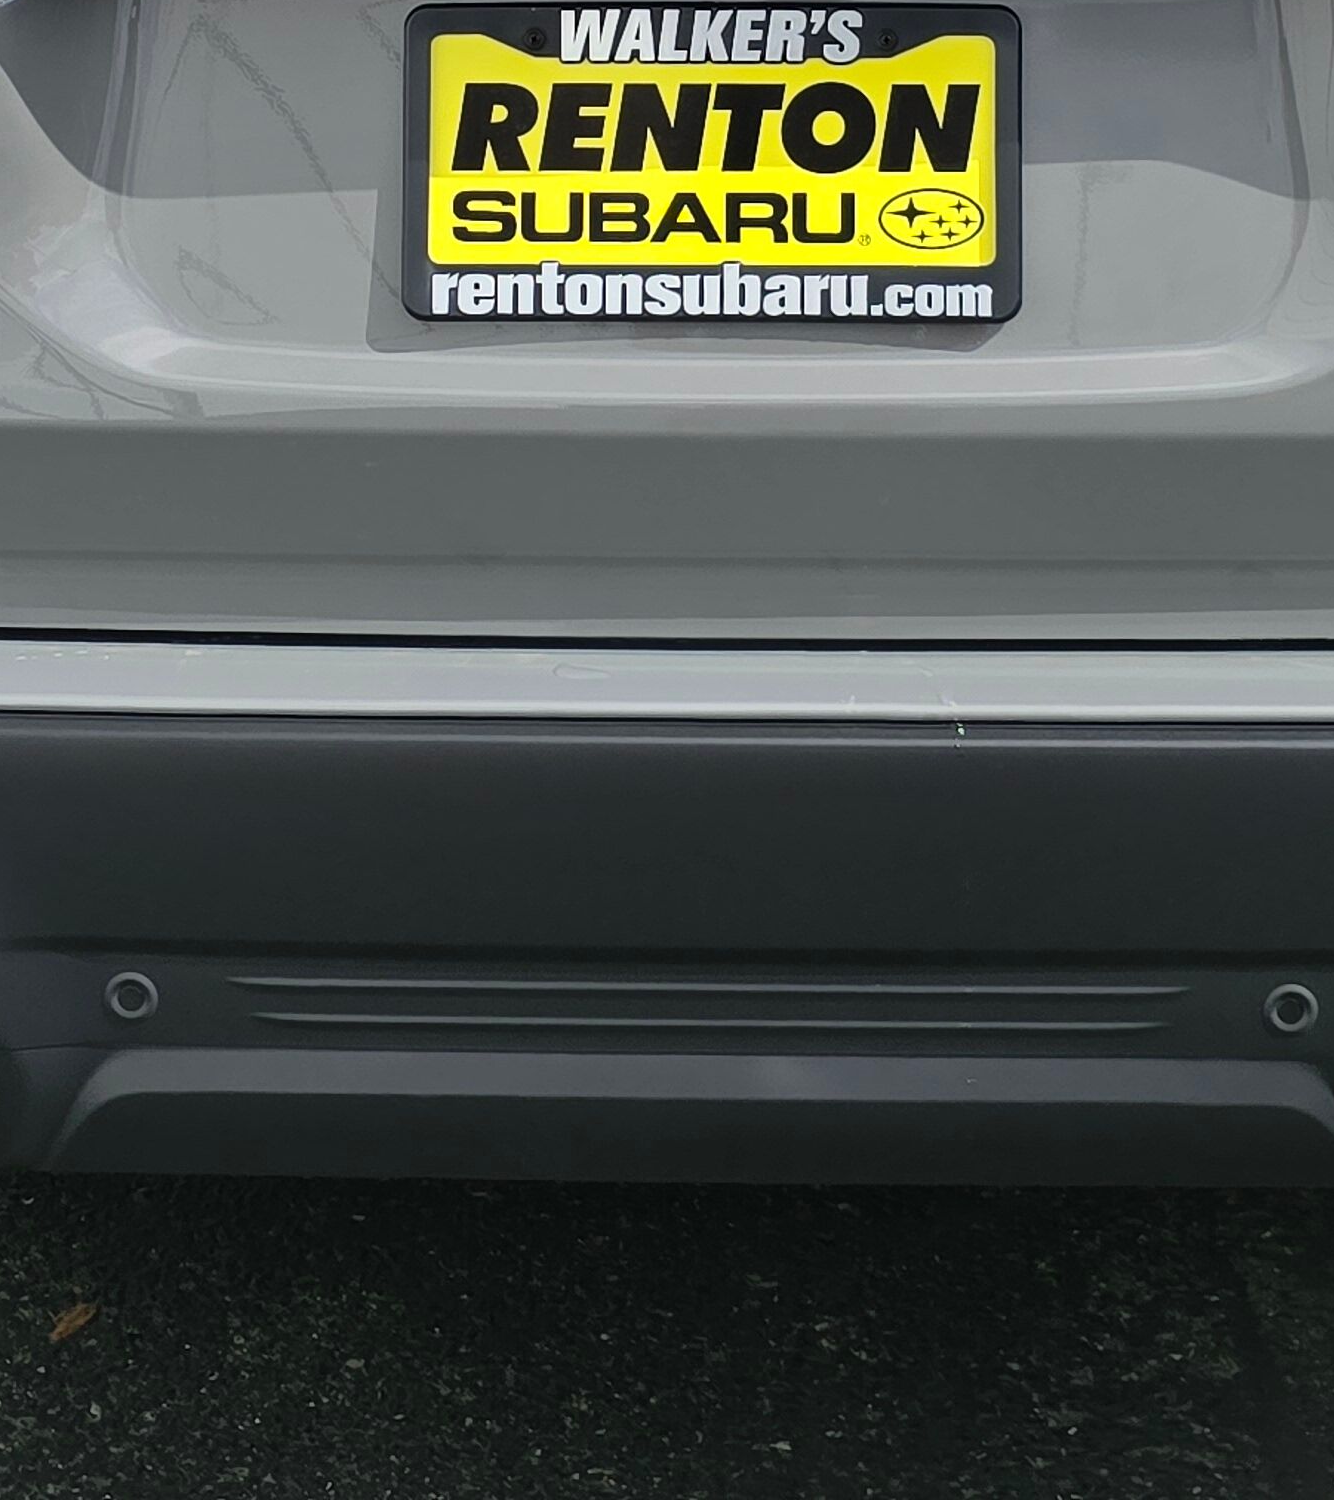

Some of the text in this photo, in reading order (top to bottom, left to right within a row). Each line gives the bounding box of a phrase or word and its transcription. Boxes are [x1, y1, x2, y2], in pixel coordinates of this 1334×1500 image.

[560, 8, 864, 64] WALKER'S
[451, 81, 980, 174] RENTON
[452, 190, 855, 244] SUBARU
[431, 261, 993, 317] rentonsubaru.com
